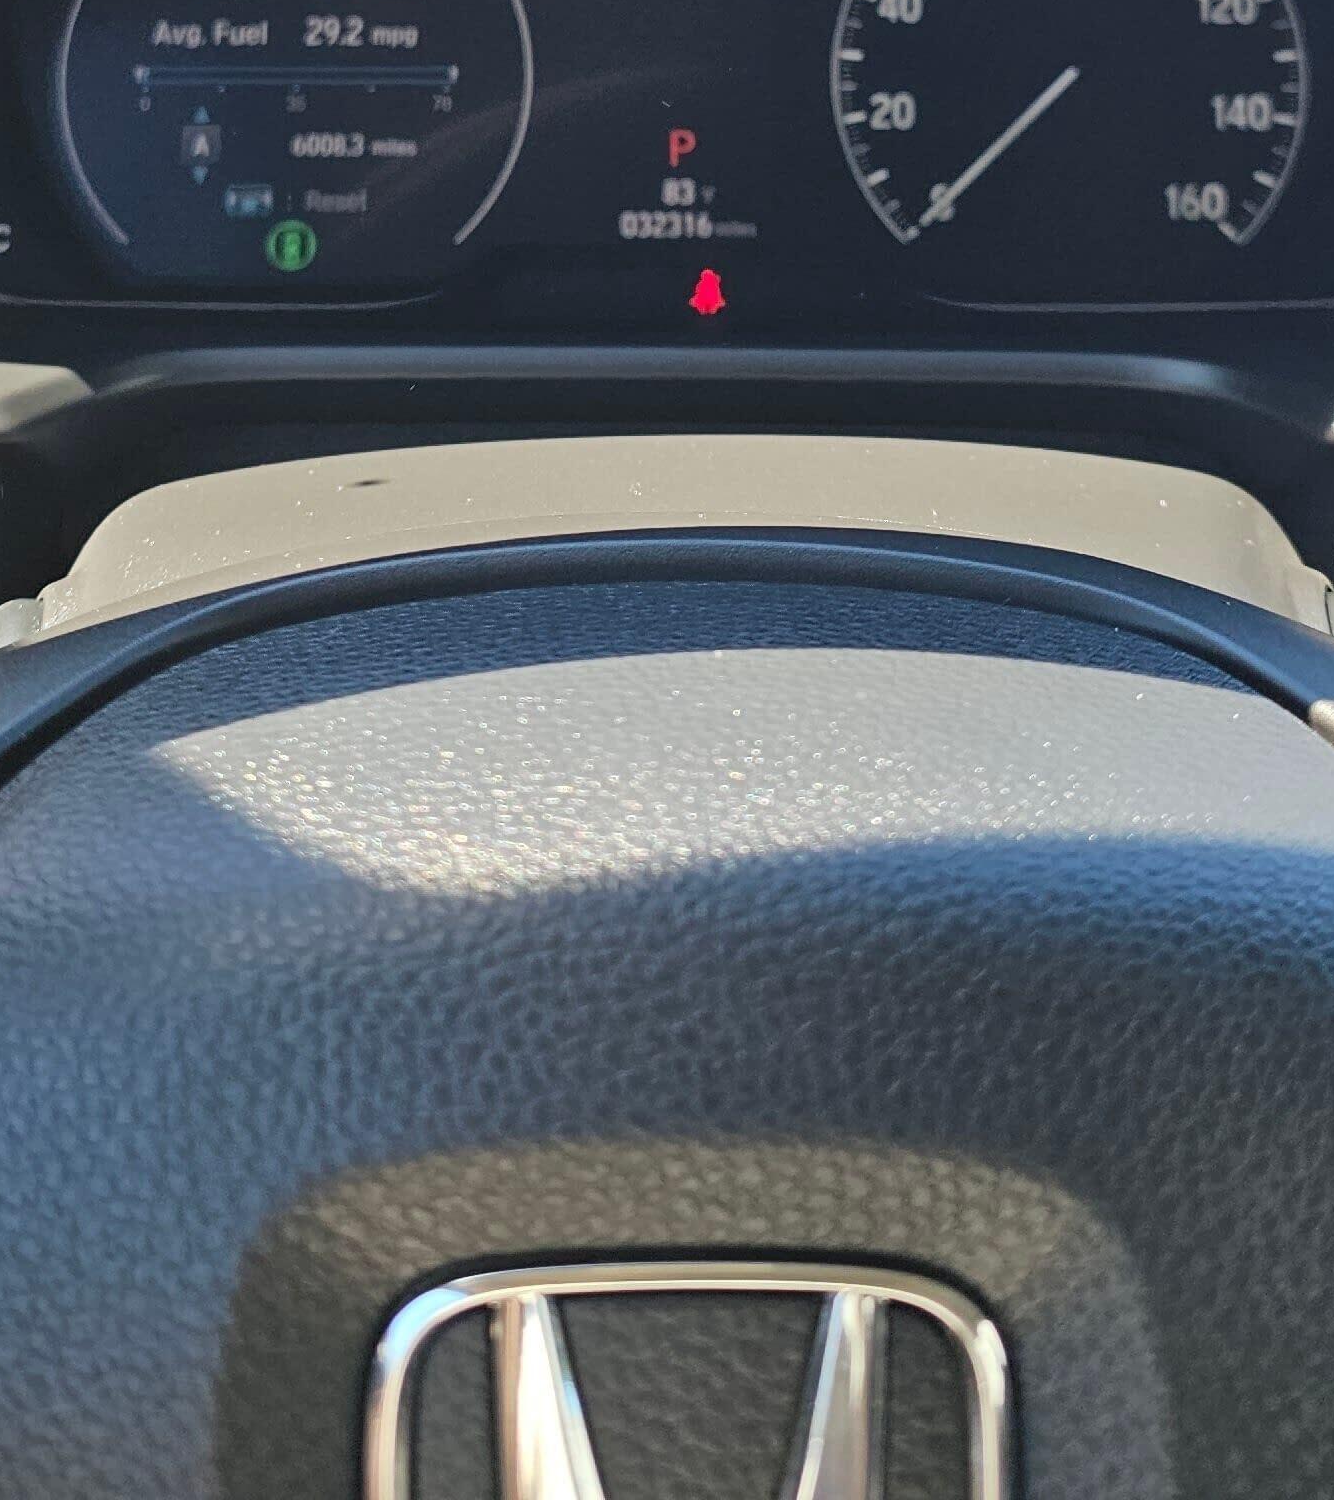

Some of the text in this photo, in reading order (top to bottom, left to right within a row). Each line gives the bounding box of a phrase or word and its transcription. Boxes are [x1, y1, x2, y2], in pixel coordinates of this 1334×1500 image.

[153, 17, 418, 49] Avg. Fuel 29.2 mpg
[870, 92, 916, 130] 20
[1212, 94, 1273, 130] 140
[669, 129, 696, 168] P
[1165, 182, 1228, 221] 160
